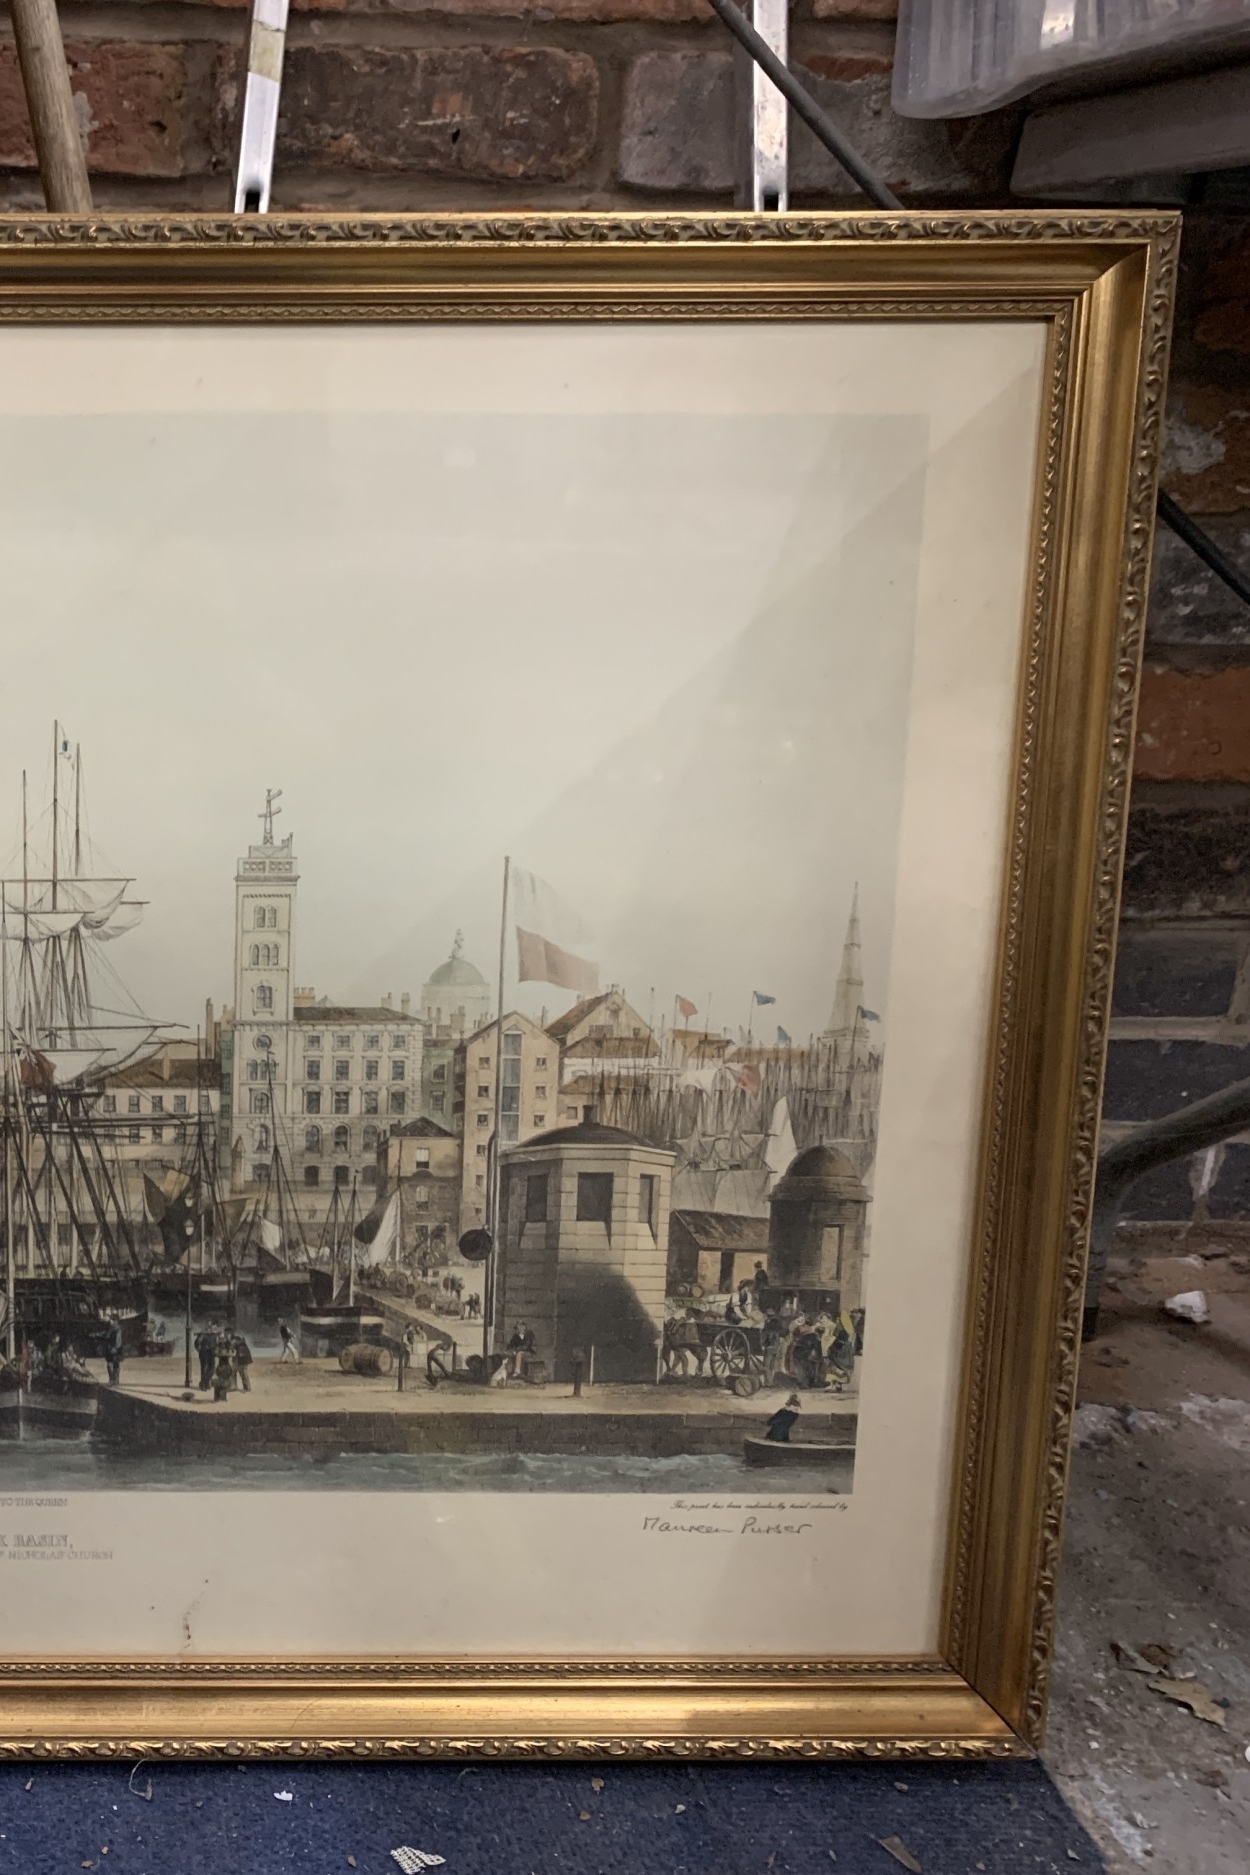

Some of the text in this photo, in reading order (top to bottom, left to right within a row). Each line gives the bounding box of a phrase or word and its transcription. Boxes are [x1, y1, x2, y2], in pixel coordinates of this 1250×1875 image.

[0, 1497, 13, 1506] TO
[12, 1535, 73, 1549] BASIN,
[66, 1550, 114, 1560] CHURCH
